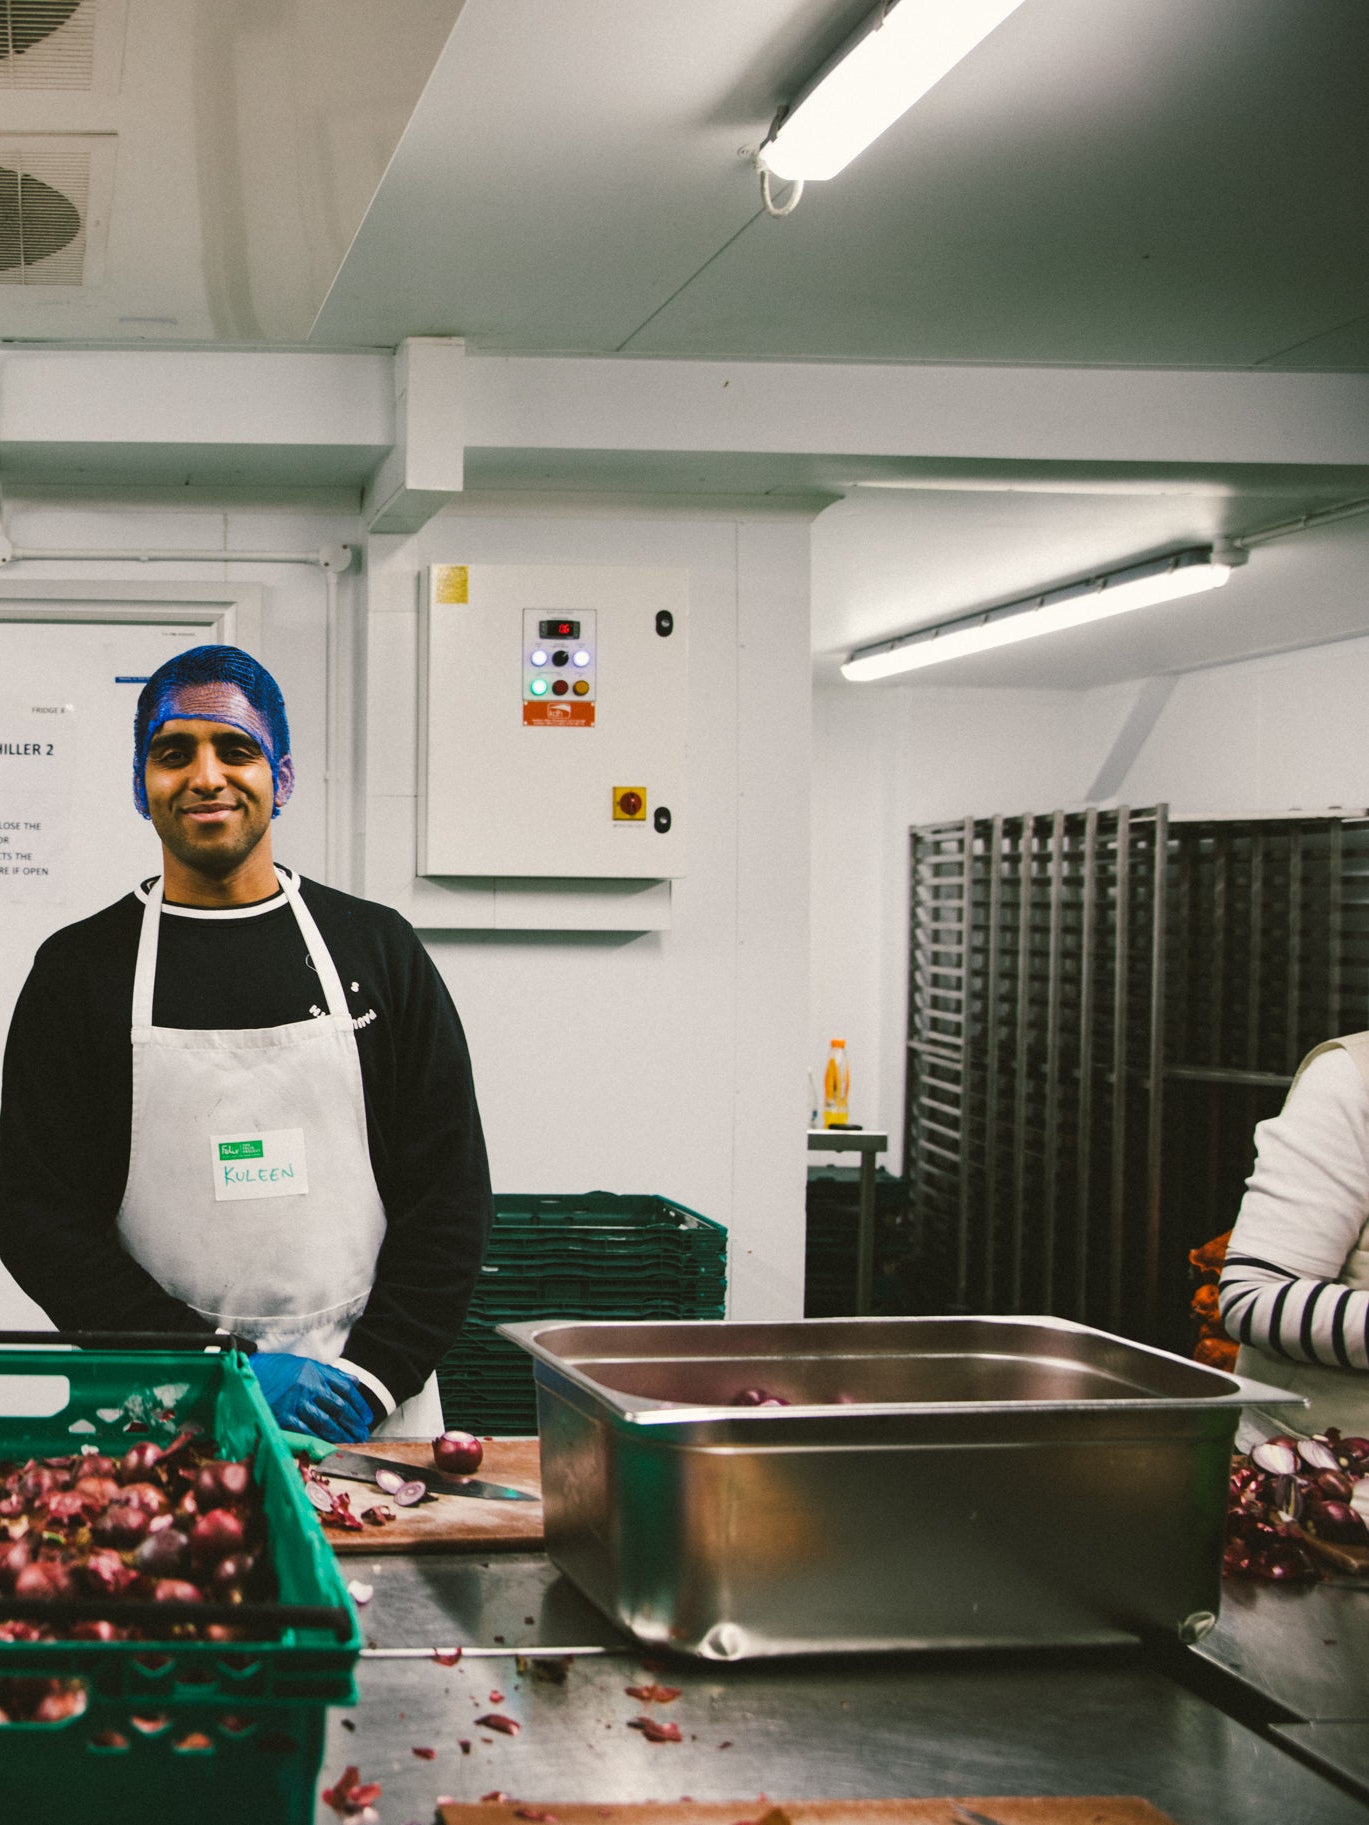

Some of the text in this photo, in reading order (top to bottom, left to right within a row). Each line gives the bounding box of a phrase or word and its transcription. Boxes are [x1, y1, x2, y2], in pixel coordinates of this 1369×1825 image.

[46, 744, 54, 755] 2
[24, 822, 41, 830] THE
[15, 852, 32, 861] THE
[12, 867, 19, 875] IF
[22, 867, 49, 875] OPEN
[224, 1163, 294, 1186] KULEEN
